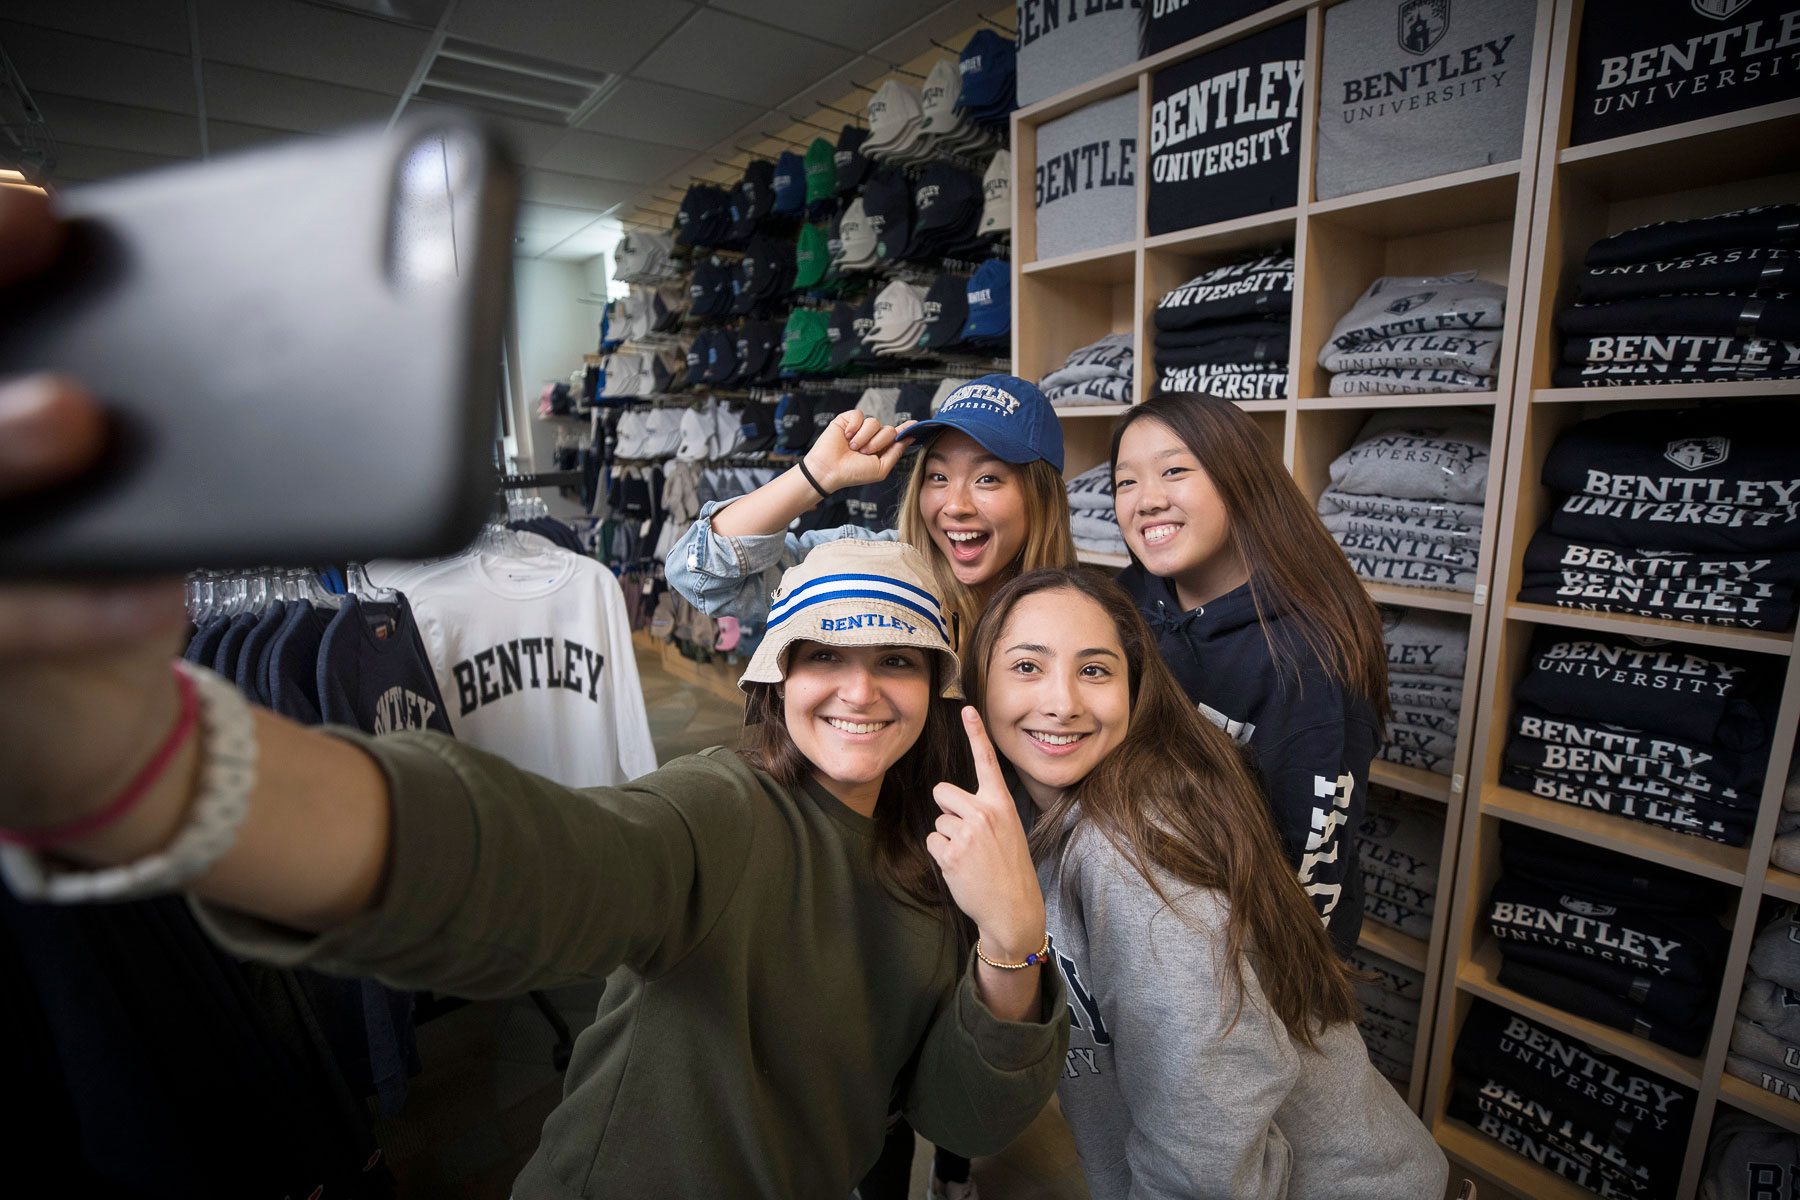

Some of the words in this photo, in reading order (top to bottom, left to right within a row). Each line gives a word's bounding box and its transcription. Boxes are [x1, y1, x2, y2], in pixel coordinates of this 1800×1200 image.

[1343, 34, 1515, 105] BENTLEY
[1151, 60, 1304, 155] BENTLEY
[1343, 71, 1507, 124] UNIVERSITY
[1153, 121, 1293, 184] UNIVERSITY
[1590, 248, 1800, 275] UNIVERSIT
[1160, 373, 1290, 400] UNIVERSIT
[1582, 469, 1800, 507] BENTLEY
[1348, 555, 1466, 585] NTLEY
[820, 613, 917, 635] BENTLEY
[453, 637, 604, 717] BENTLEY
[1538, 658, 1735, 697] UNIVERSITY
[1544, 641, 1746, 680] BENTLEY
[1491, 901, 1682, 962] BENTLEY
[1499, 1037, 1671, 1132] UNIVERSITY
[1502, 1014, 1685, 1114] BENTLEY
